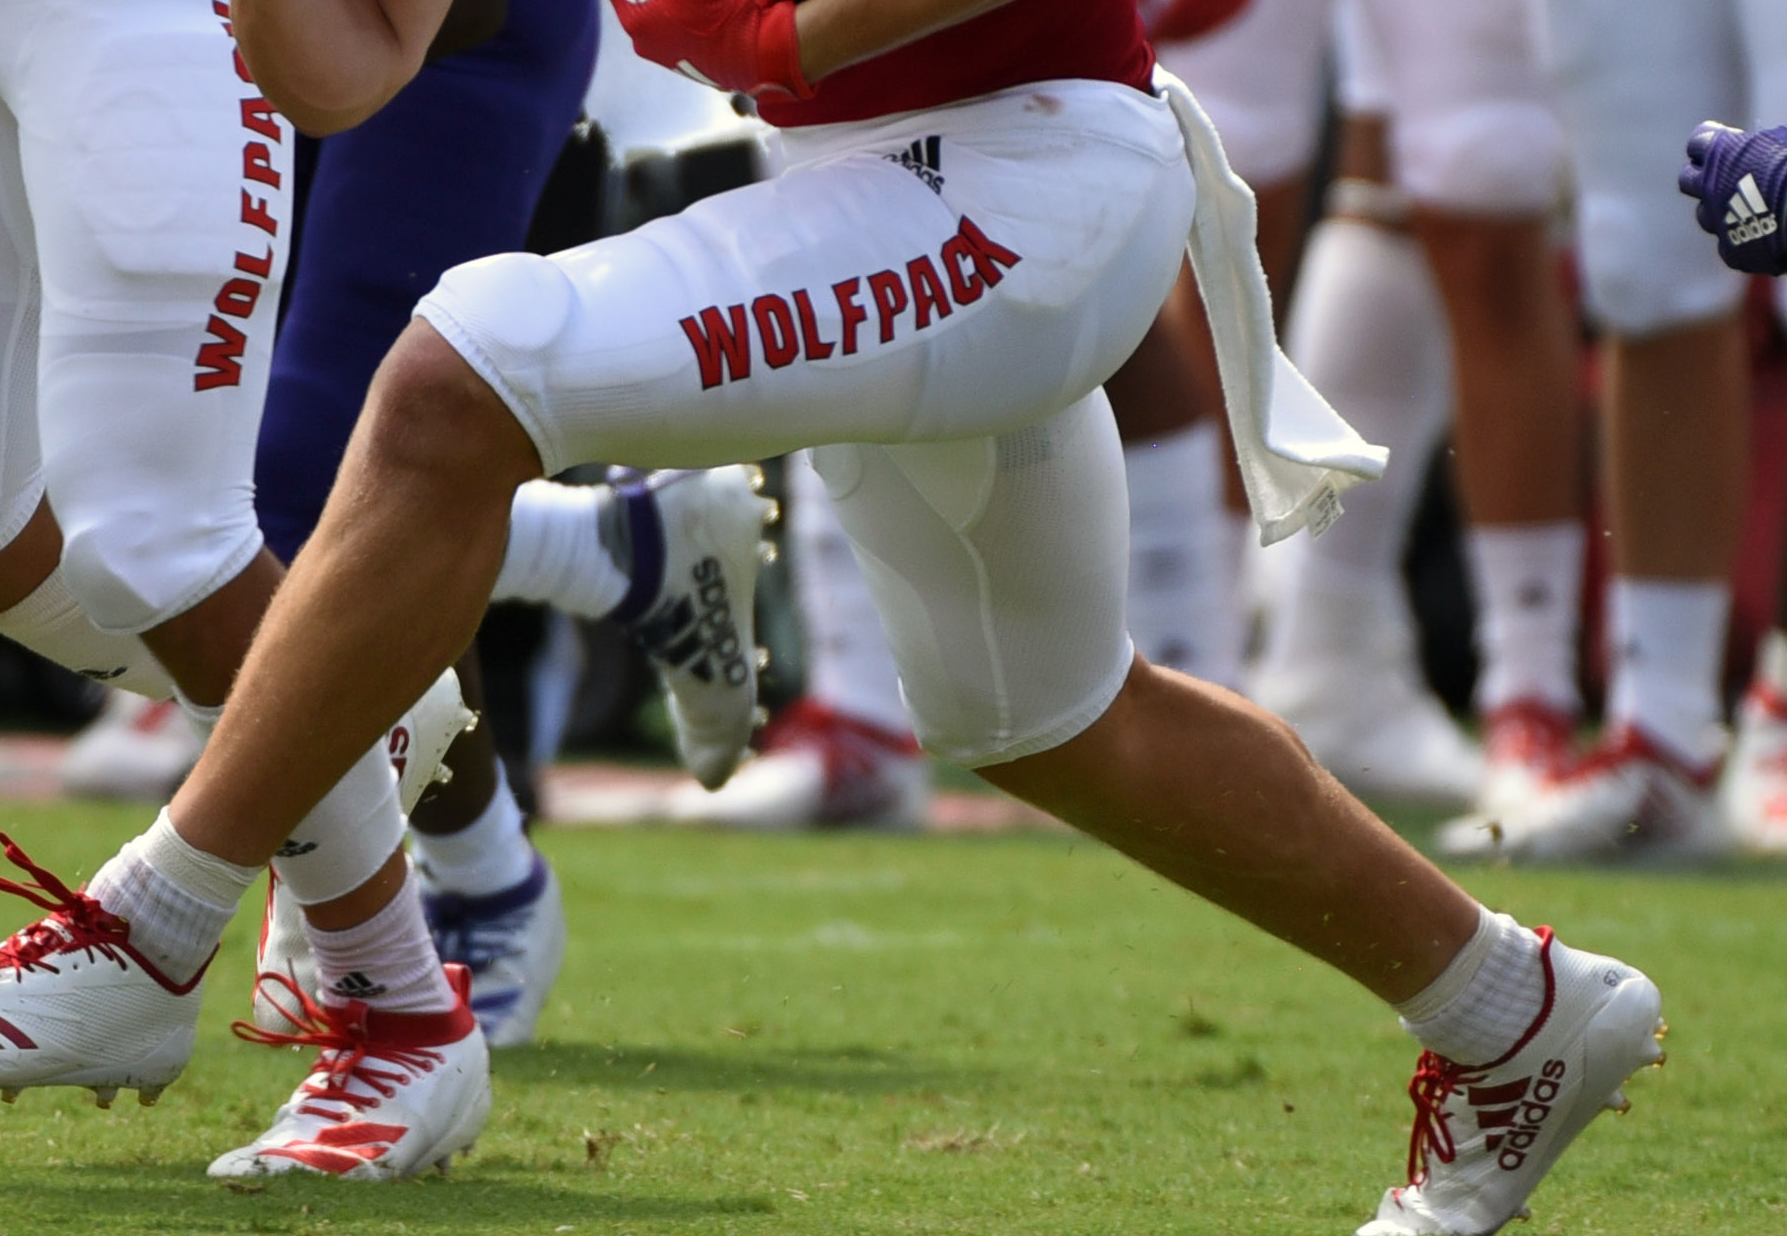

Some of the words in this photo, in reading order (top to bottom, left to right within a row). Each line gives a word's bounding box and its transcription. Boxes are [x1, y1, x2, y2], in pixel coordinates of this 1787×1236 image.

[1728, 211, 1776, 247] adidas
[678, 214, 1023, 391] WOLFPACK
[692, 556, 749, 687] adidas
[1497, 1058, 1567, 1173] adidas
